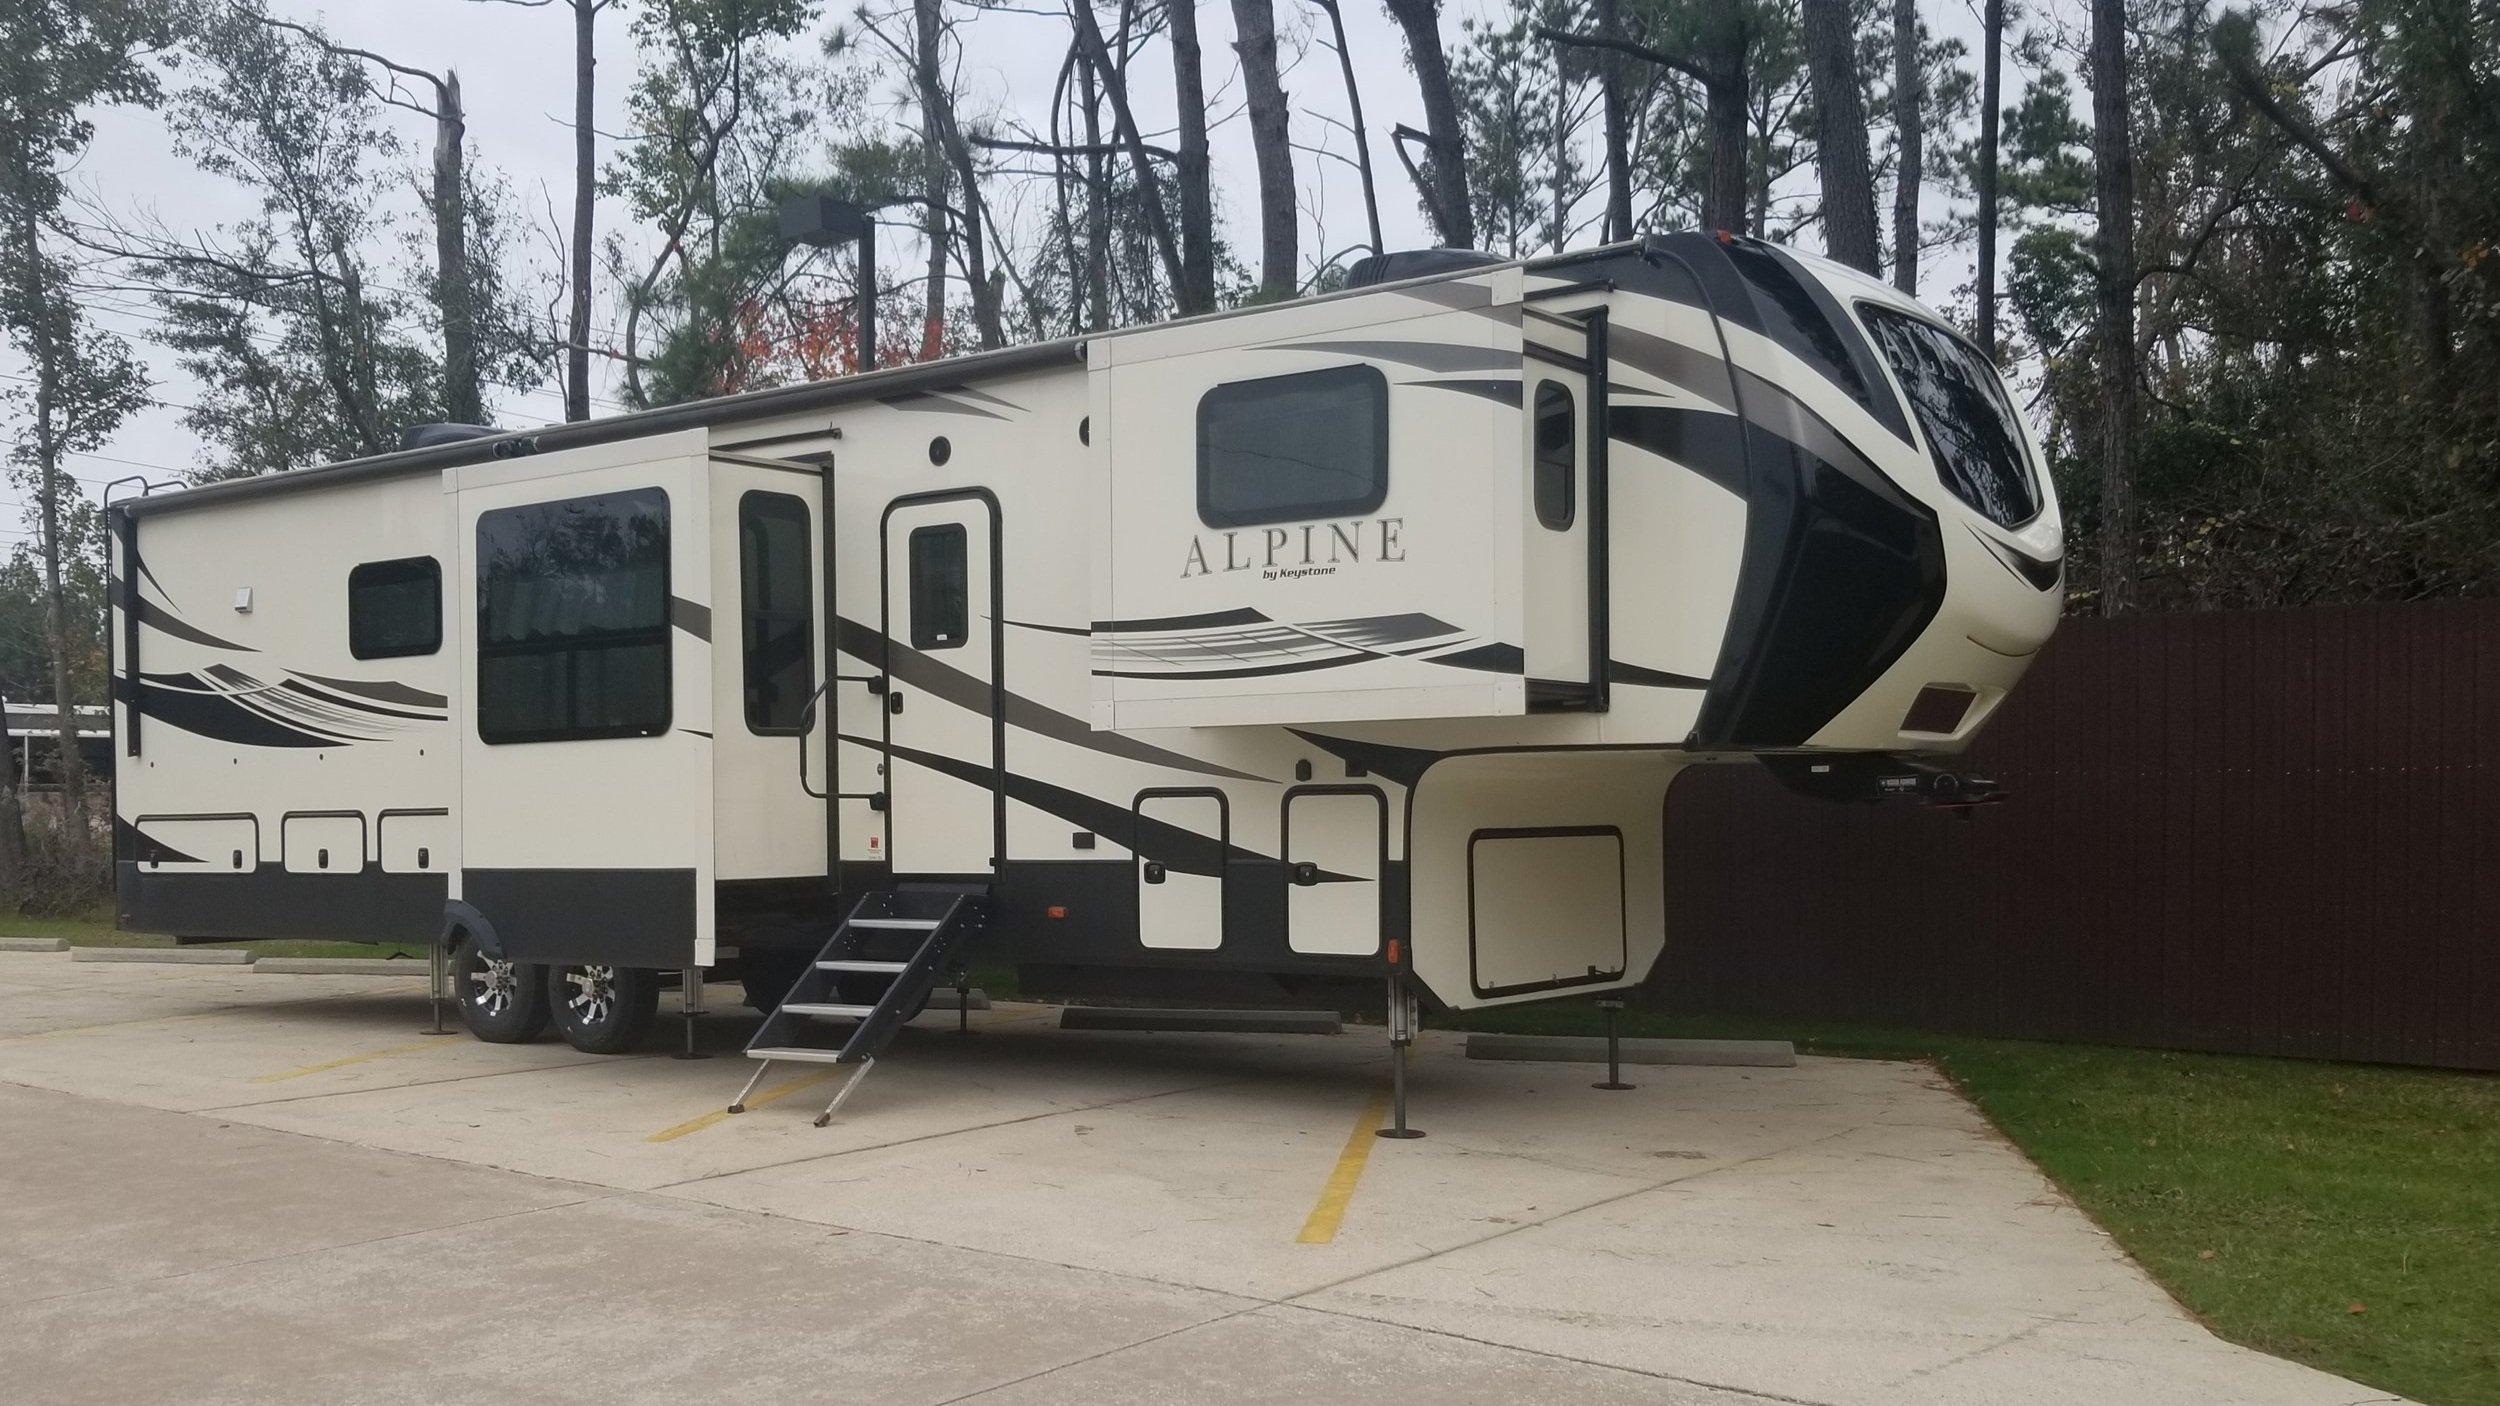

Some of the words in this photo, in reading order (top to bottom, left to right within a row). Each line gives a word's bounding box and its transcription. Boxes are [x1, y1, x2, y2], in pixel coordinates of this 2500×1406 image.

[1180, 518, 1406, 578] ALPINE
[1262, 569, 1278, 581] by
[1279, 567, 1336, 579] Keystone
